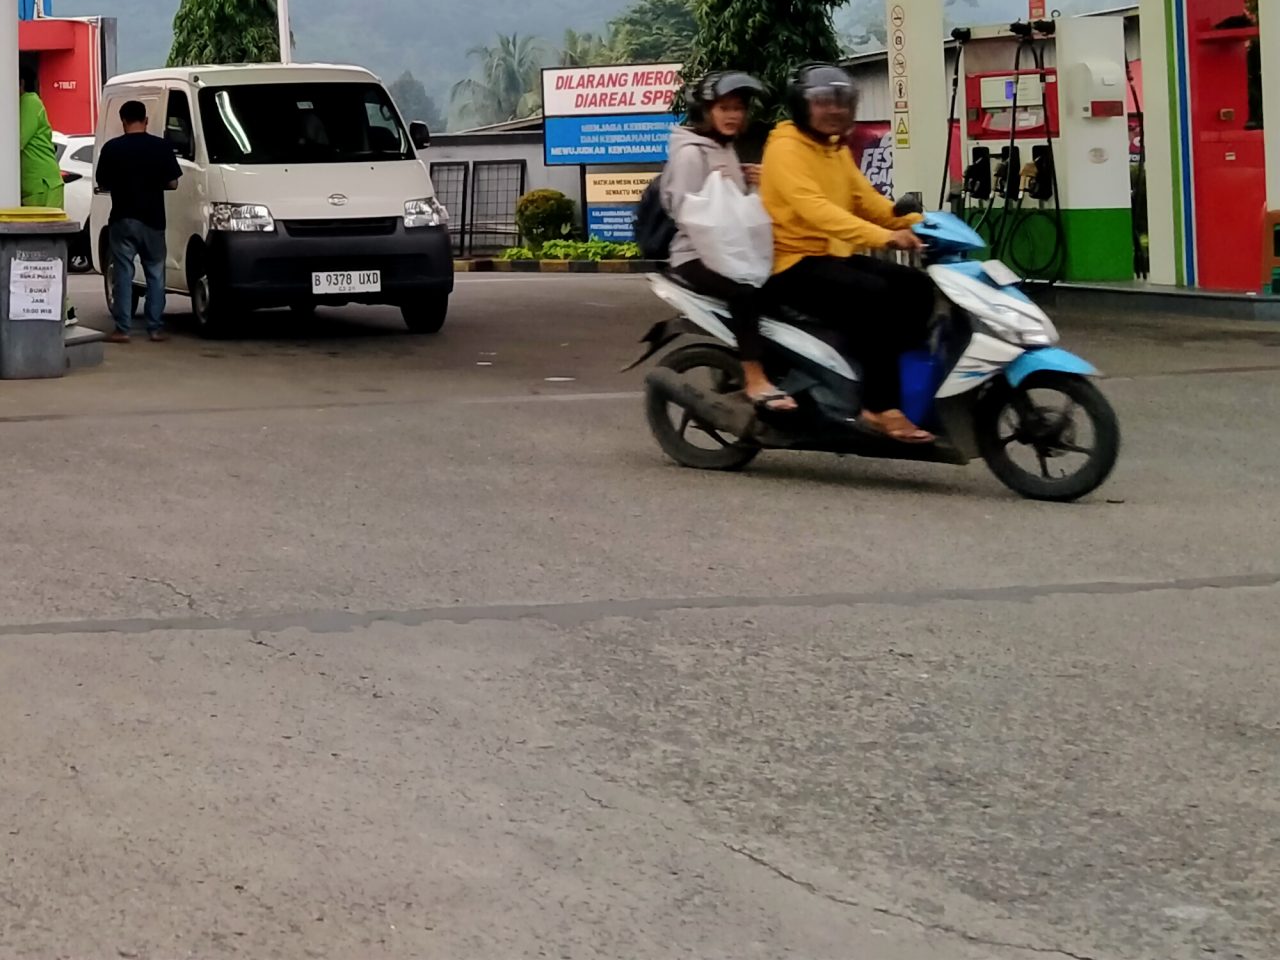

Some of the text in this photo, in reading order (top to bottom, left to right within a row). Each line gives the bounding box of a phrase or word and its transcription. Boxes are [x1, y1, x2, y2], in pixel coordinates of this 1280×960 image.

[555, 72, 629, 90] DILARANG
[575, 90, 674, 108] DIAREAL SPB
[860, 147, 892, 176] FES
[314, 272, 379, 286] B 9378 UXD
